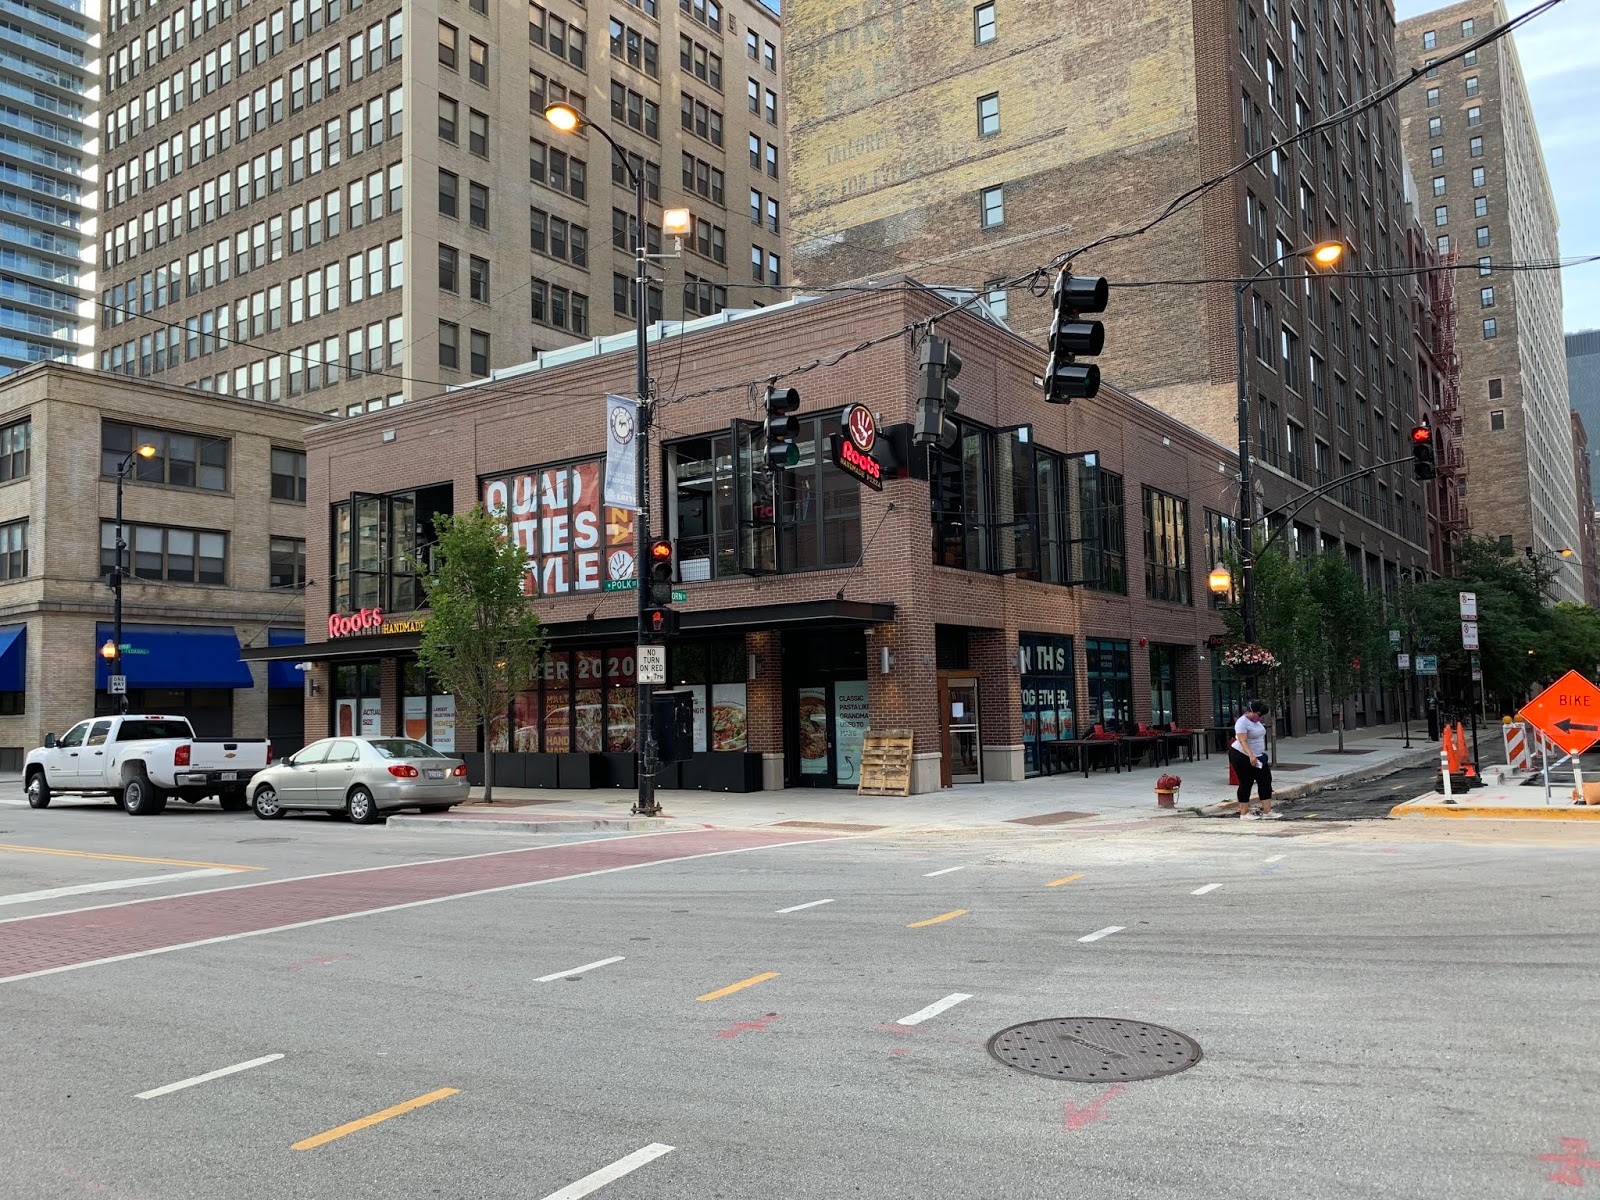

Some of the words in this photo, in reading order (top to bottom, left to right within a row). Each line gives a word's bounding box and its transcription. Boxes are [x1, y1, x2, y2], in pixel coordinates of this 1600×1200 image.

[842, 440, 880, 478] Roots
[839, 457, 866, 478] HANDMADE
[866, 473, 882, 489] PIZZA
[486, 468, 582, 518] QUAD
[611, 580, 632, 590] POLK
[328, 607, 383, 638] Roots
[646, 648, 656, 656] NO
[1036, 645, 1065, 671] THS
[578, 656, 635, 679] 2020
[643, 656, 660, 664] TURN
[640, 664, 649, 672] ON
[651, 664, 664, 672] RED
[546, 695, 569, 703] MALT
[1021, 689, 1067, 706] OGETHER
[1559, 694, 1591, 707] BIKE
[546, 735, 570, 746] HAND
